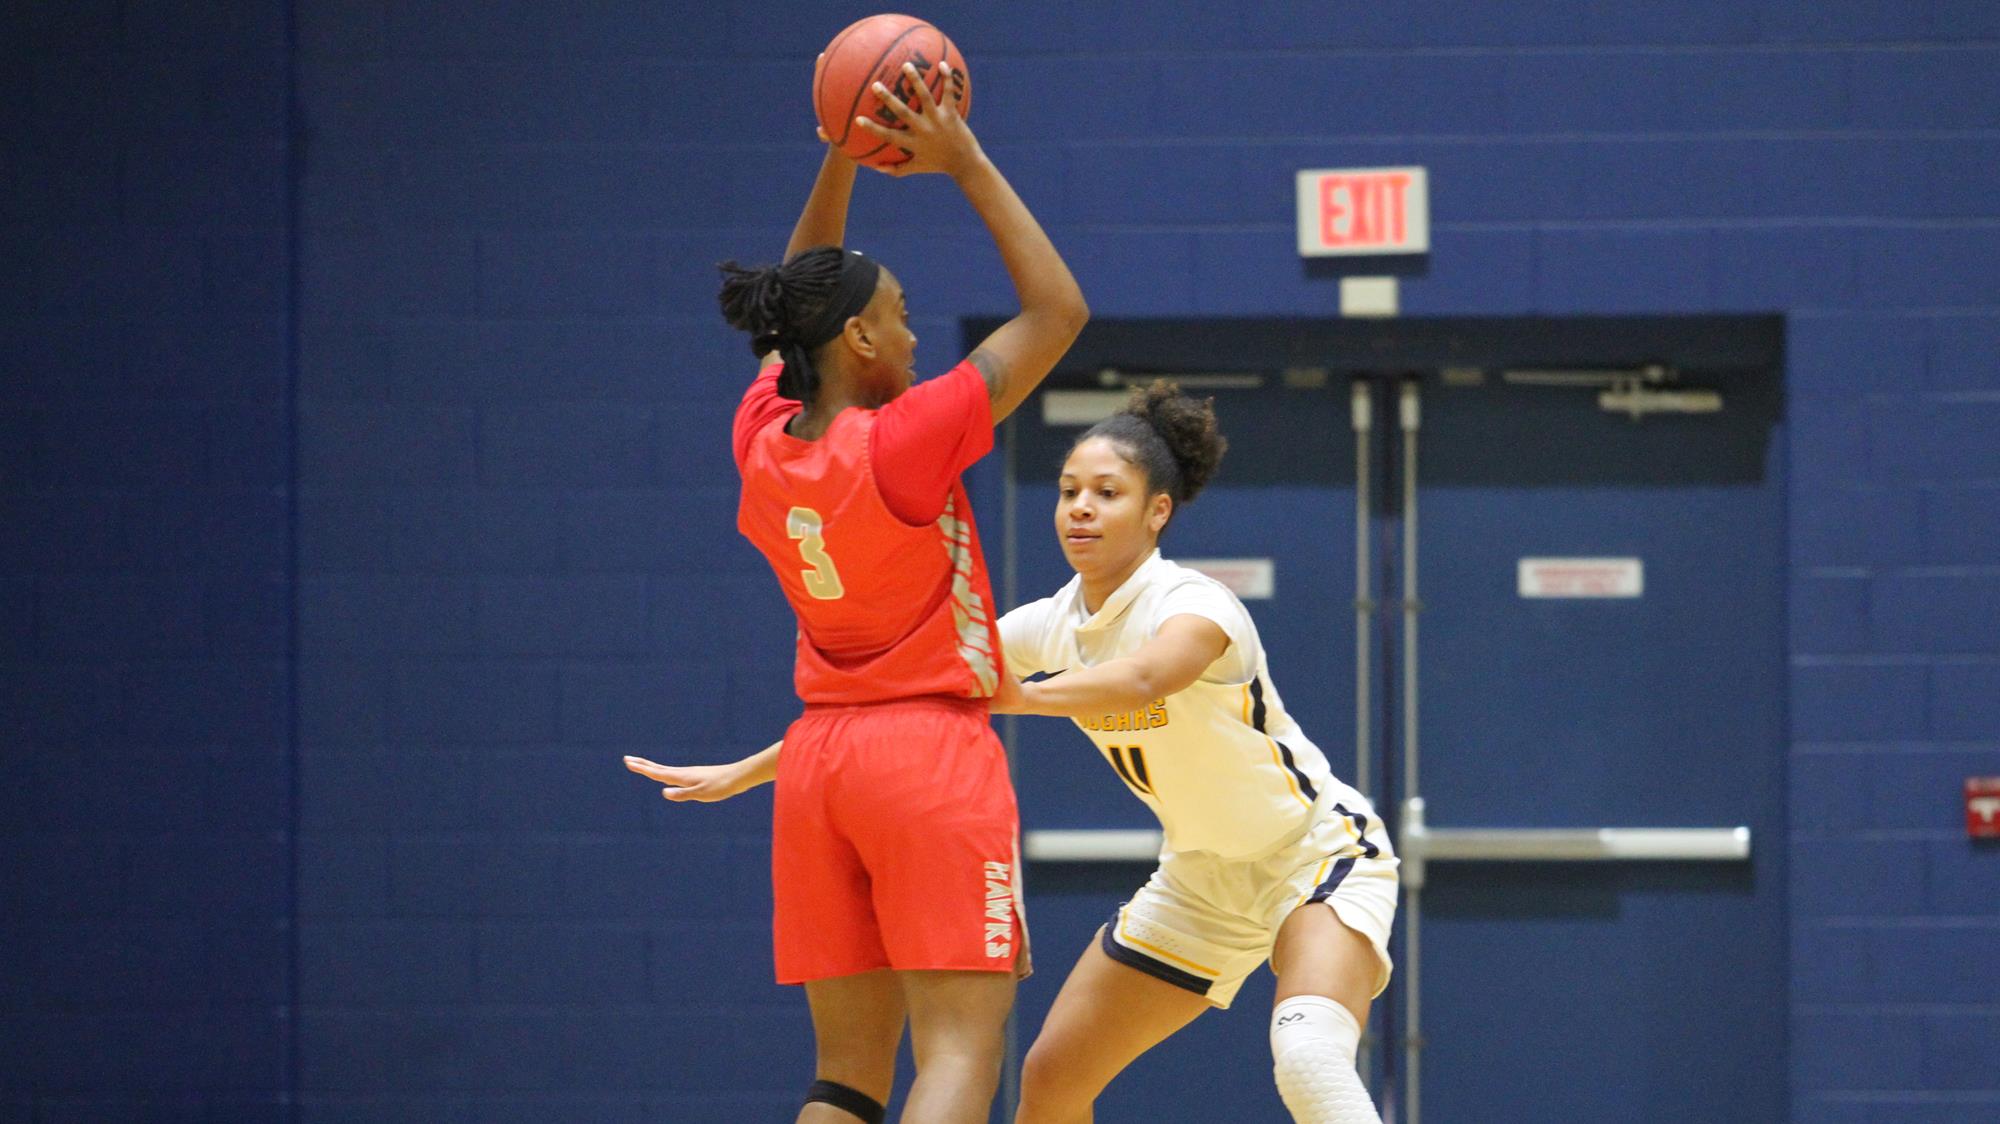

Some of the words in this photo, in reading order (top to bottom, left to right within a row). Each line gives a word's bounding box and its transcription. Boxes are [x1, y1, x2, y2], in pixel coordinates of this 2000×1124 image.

[1319, 172, 1412, 247] EXIT
[786, 506, 845, 600] 3
[983, 861, 1013, 958] HAWKS
